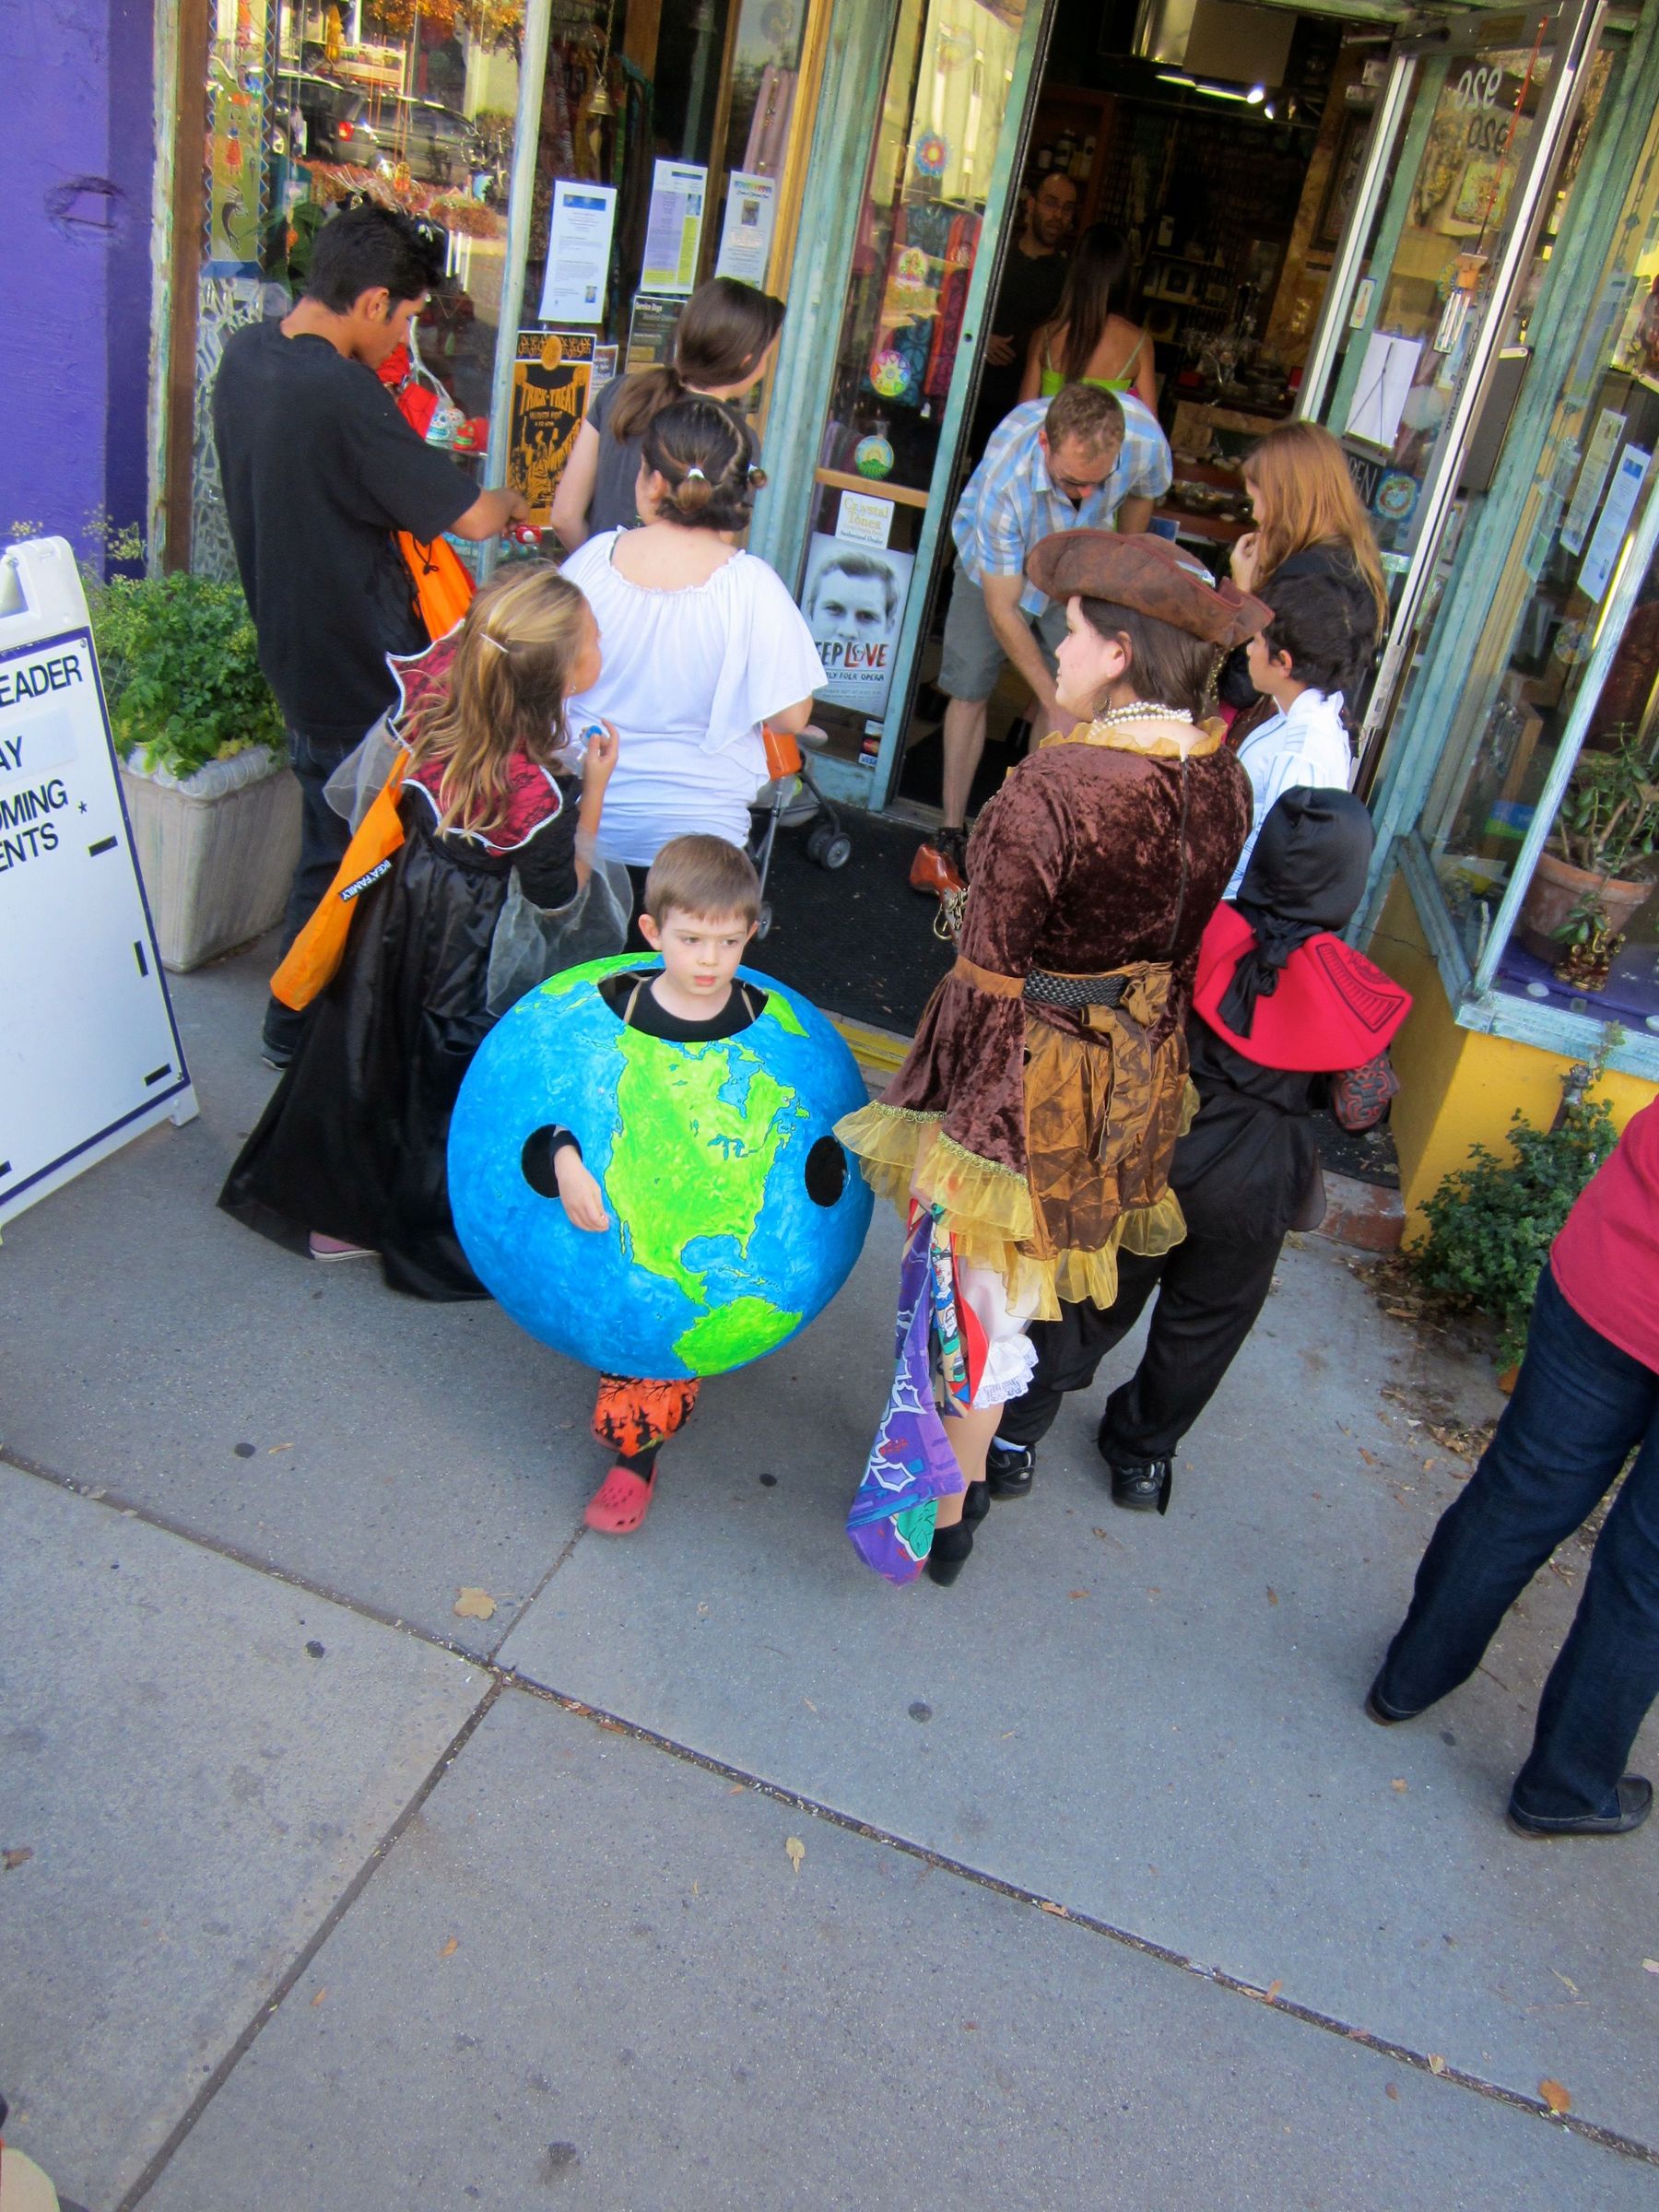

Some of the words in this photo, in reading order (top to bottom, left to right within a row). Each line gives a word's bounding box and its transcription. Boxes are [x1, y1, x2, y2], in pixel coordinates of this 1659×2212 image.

[1464, 313, 1483, 371] YOUR
[520, 380, 547, 416] TRICK
[550, 382, 576, 417] TREAT
[1444, 377, 1464, 433] STEP
[1347, 456, 1378, 503] PEN
[815, 641, 843, 665] EEP
[844, 641, 889, 668] LOVE
[840, 672, 857, 680] FOLK
[861, 672, 885, 681] OPERA
[0, 779, 69, 830] MING
[370, 859, 392, 878] IKEA
[342, 875, 373, 900] FAMILY
